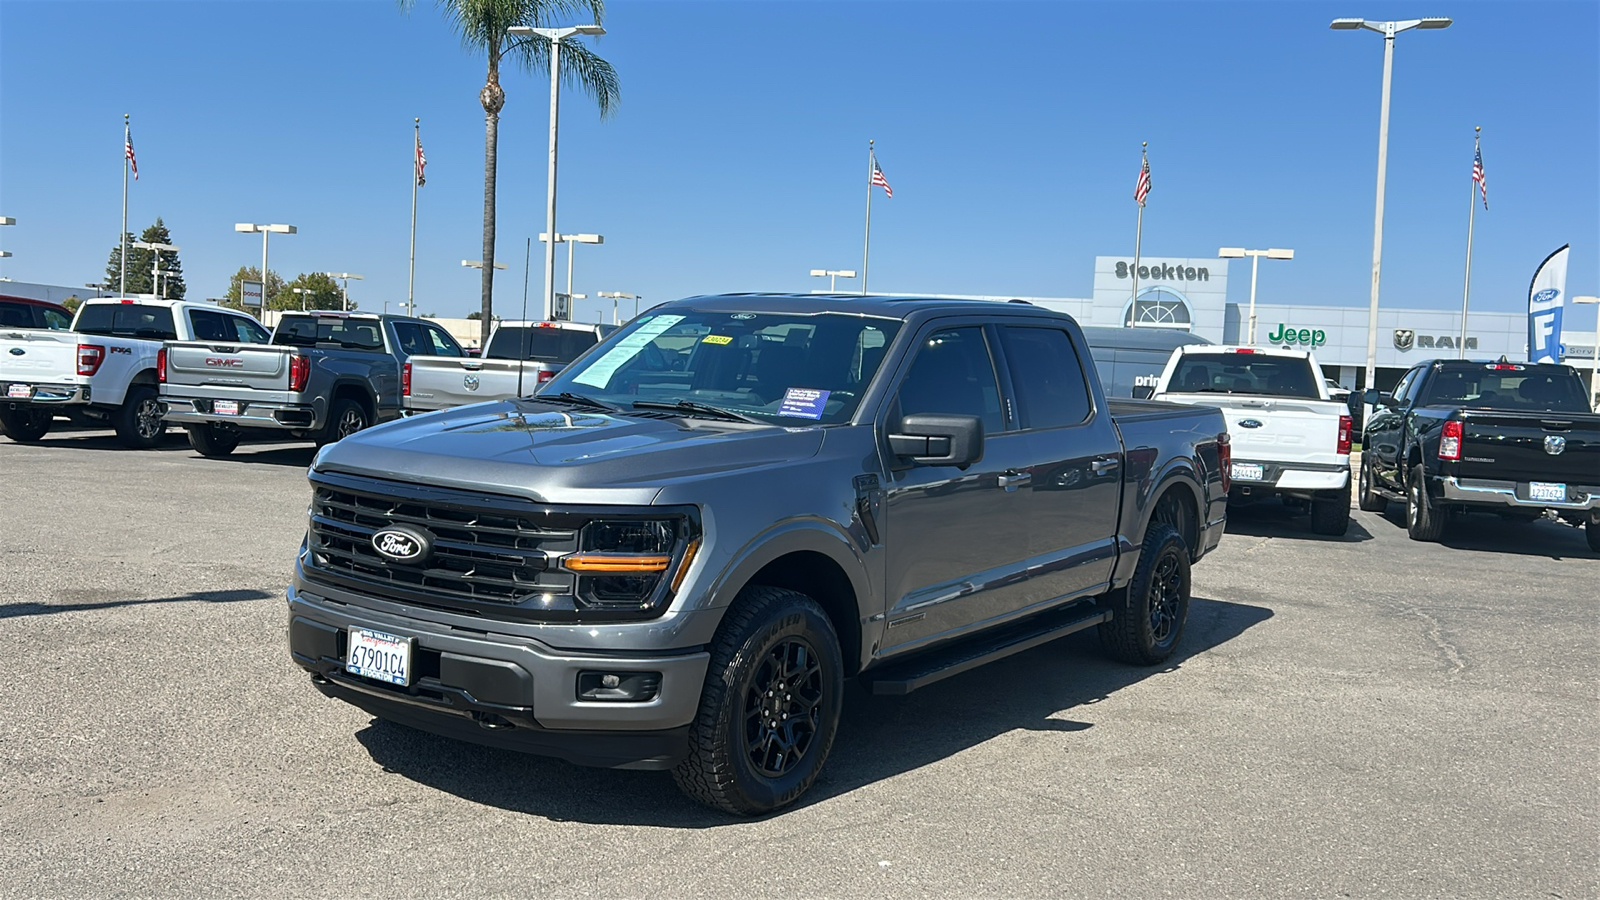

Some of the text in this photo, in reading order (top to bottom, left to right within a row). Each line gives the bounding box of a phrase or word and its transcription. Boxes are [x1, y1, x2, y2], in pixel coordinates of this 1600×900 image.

[1115, 261, 1209, 281] Stockton
[1268, 323, 1327, 349] Jeep
[1417, 335, 1478, 349] RAM
[205, 357, 243, 367] GMC
[380, 533, 412, 555] Ford
[362, 629, 395, 642] BIG VALLEY
[351, 645, 404, 676] 67901C4
[361, 667, 393, 682] STOCKTON
